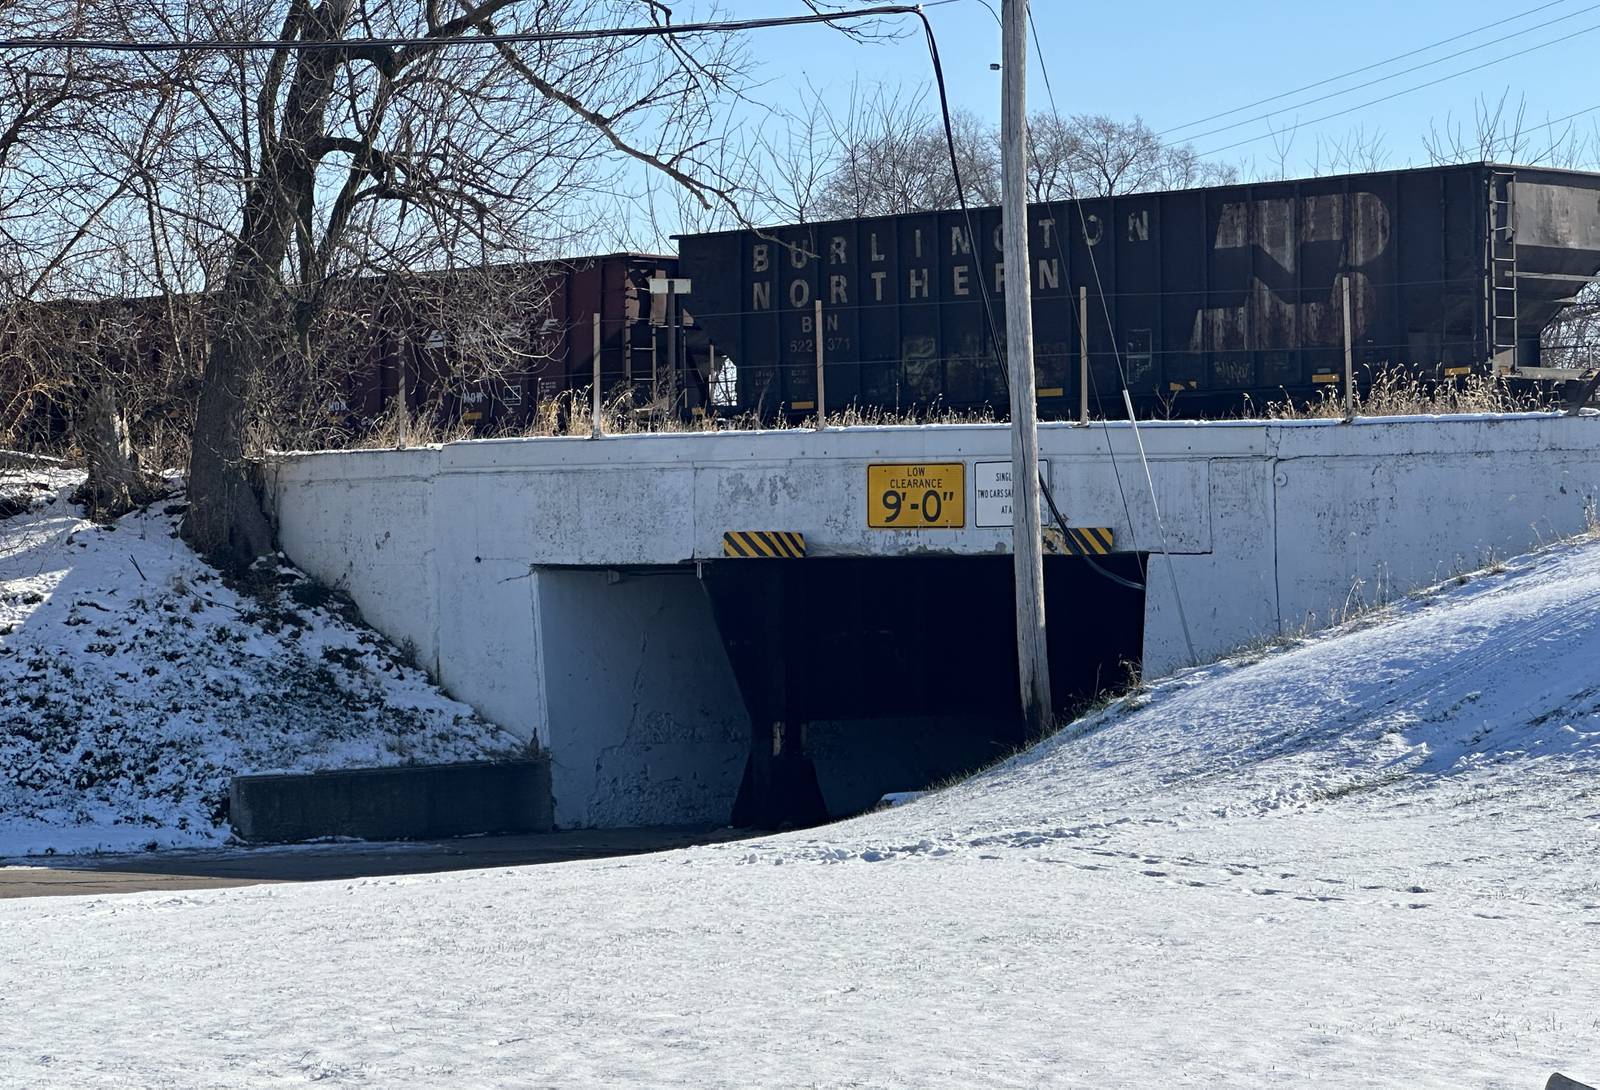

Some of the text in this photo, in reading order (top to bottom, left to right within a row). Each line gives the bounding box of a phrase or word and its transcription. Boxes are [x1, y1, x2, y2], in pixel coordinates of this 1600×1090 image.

[907, 467, 925, 477] LOW
[995, 472, 1012, 482] SINGL
[890, 479, 943, 489] CLEARANCE
[977, 489, 989, 499] TWO
[990, 488, 1004, 499] CARS
[882, 490, 954, 523] 9'-0"
[1001, 505, 1008, 514] AT
